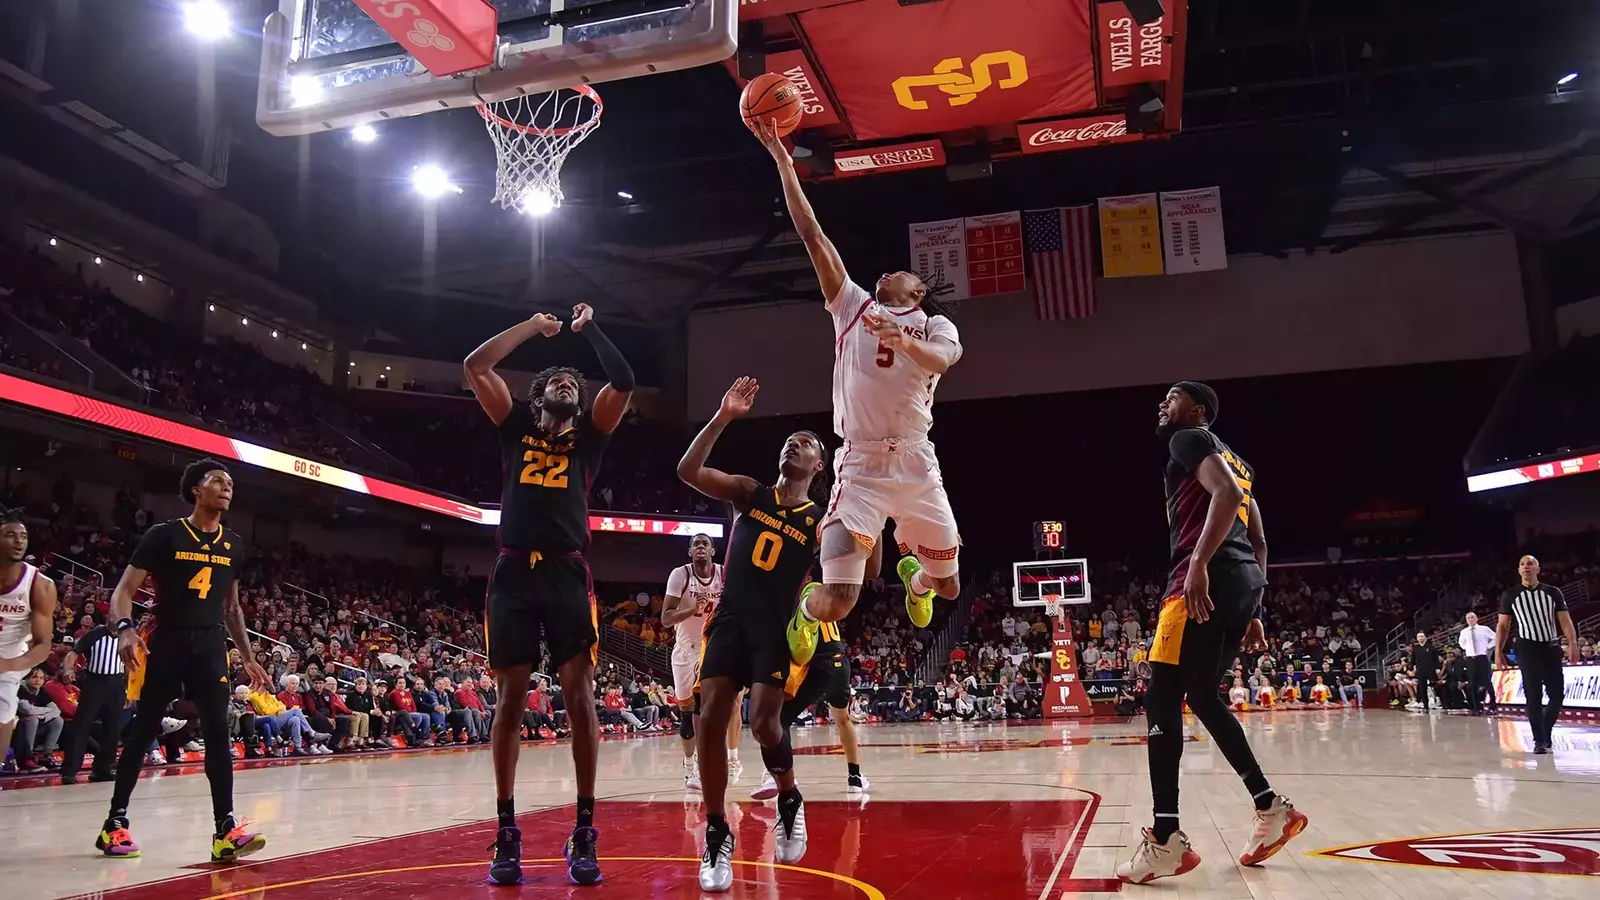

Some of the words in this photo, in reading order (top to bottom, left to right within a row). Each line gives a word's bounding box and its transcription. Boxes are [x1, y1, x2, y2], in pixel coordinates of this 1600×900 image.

[1109, 17, 1132, 72] WELLS
[783, 66, 824, 115] WELLS
[1029, 119, 1127, 146] Coca-Cola
[838, 158, 871, 168] USC
[872, 146, 935, 160] CREDIT
[875, 154, 934, 166] UNION
[1166, 208, 1217, 218] APPEARANCES
[914, 239, 961, 249] APPEARANCES
[876, 343, 895, 368] 5
[294, 459, 307, 474] GO
[308, 464, 321, 478] SC
[520, 450, 569, 488] 22
[748, 508, 783, 530] ARIZONA
[782, 524, 808, 546] STATE
[1043, 522, 1063, 533] 3:30
[1047, 532, 1059, 547] 10
[174, 551, 209, 563] ARIZONA
[210, 555, 232, 566] STATE
[751, 531, 783, 571] 0
[188, 566, 212, 600] 4
[1055, 649, 1071, 670] SC
[1564, 676, 1584, 700] with
